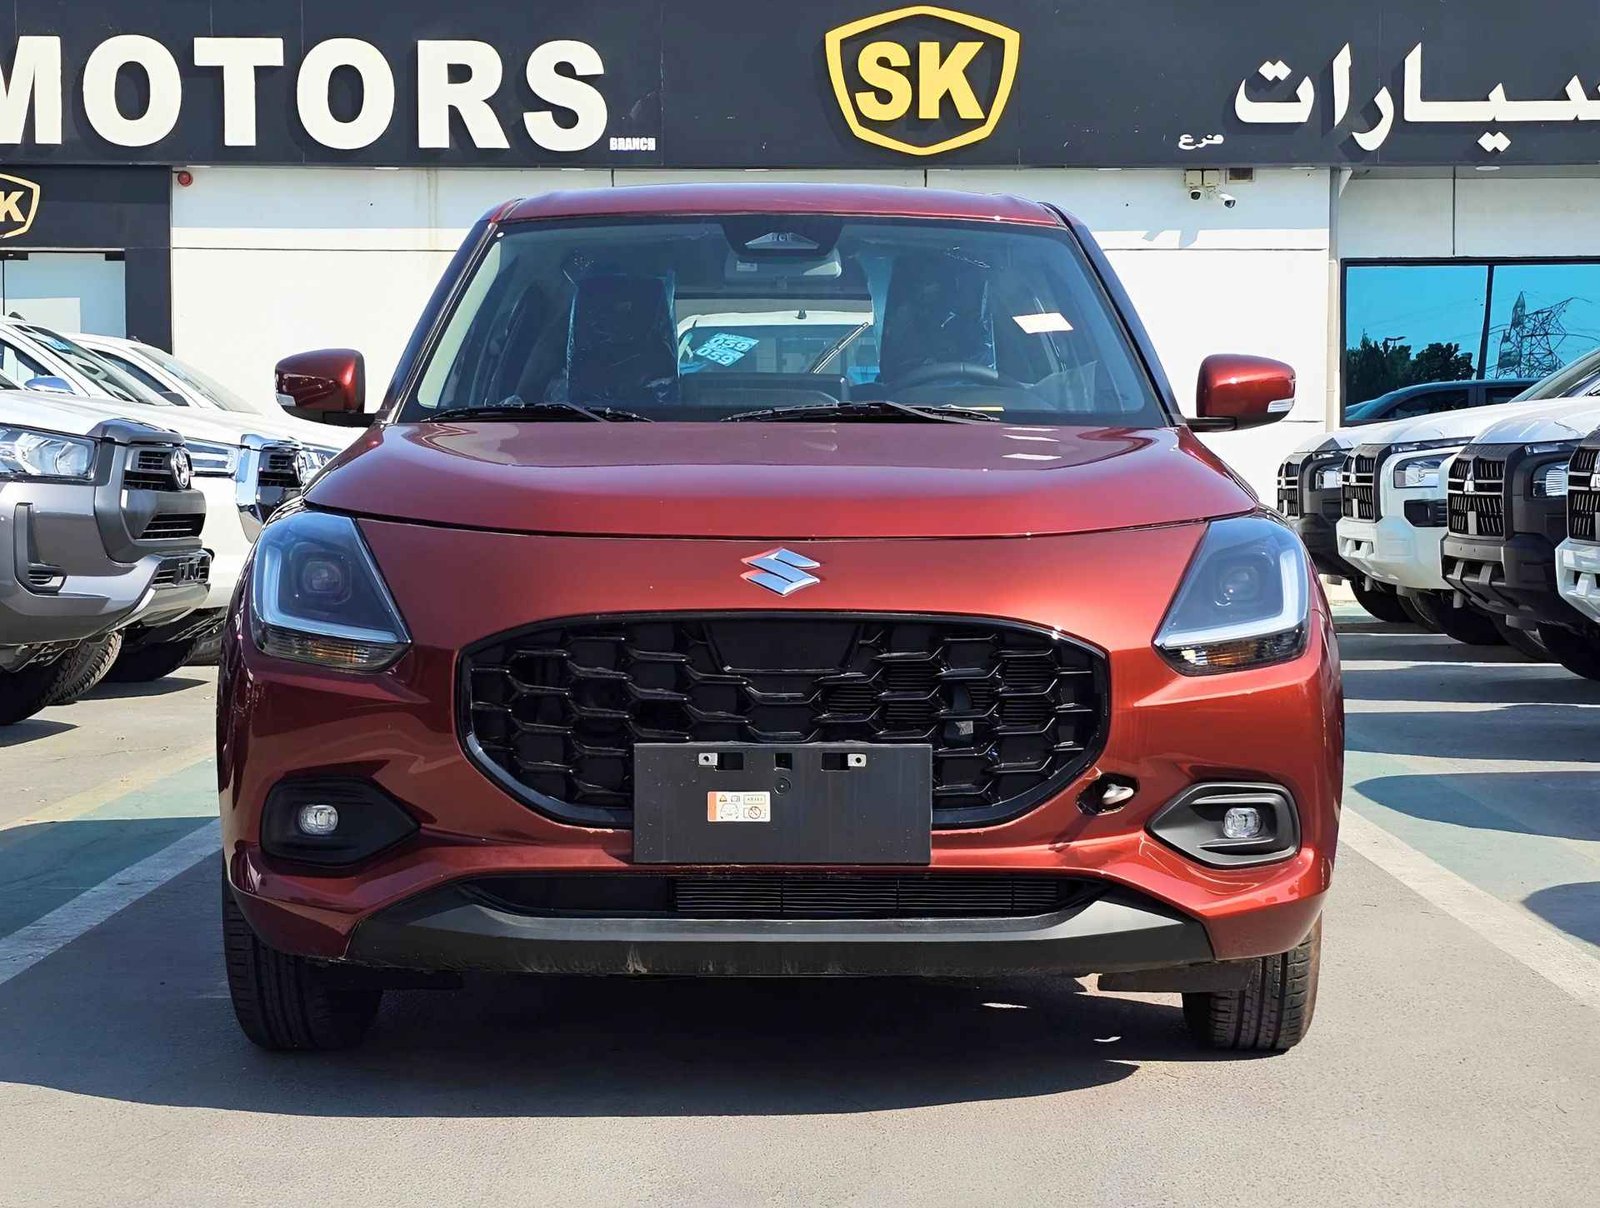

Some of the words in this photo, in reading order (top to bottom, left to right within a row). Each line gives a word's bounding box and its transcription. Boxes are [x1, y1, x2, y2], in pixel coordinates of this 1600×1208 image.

[0, 35, 608, 151] MOTORS
[855, 41, 985, 121] SK
[609, 137, 656, 151] BRANCH
[1178, 134, 1225, 150] فرع
